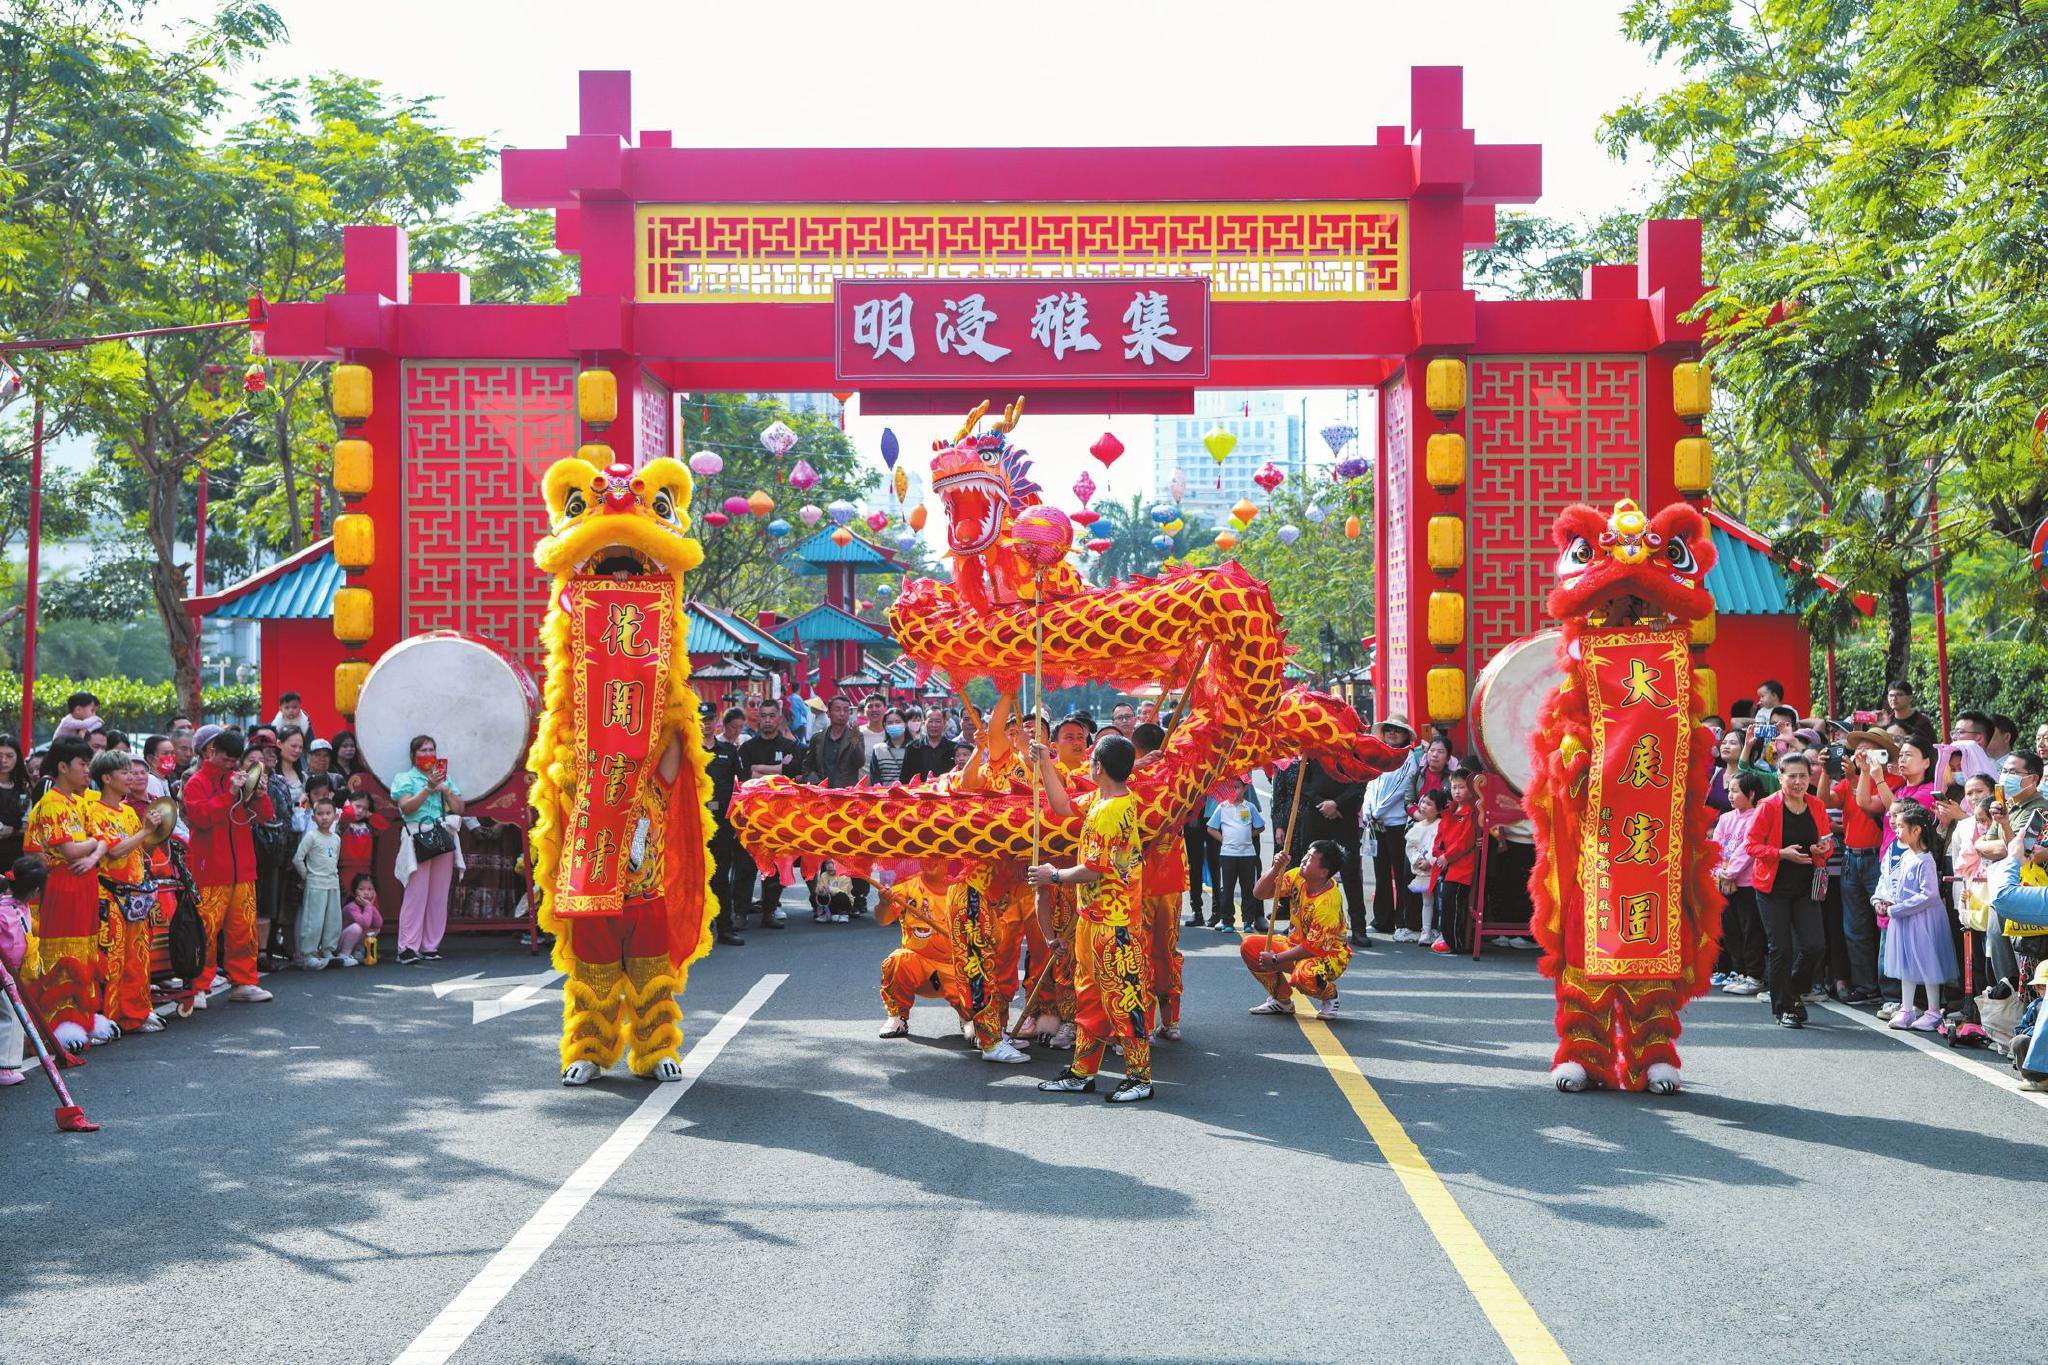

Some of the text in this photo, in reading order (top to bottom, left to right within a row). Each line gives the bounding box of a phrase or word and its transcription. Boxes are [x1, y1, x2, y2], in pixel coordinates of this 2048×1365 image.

[586, 603, 651, 884] 花開富貴
[1615, 660, 1672, 944] 大展宏圖
[1112, 944, 1146, 1012] 龍武
